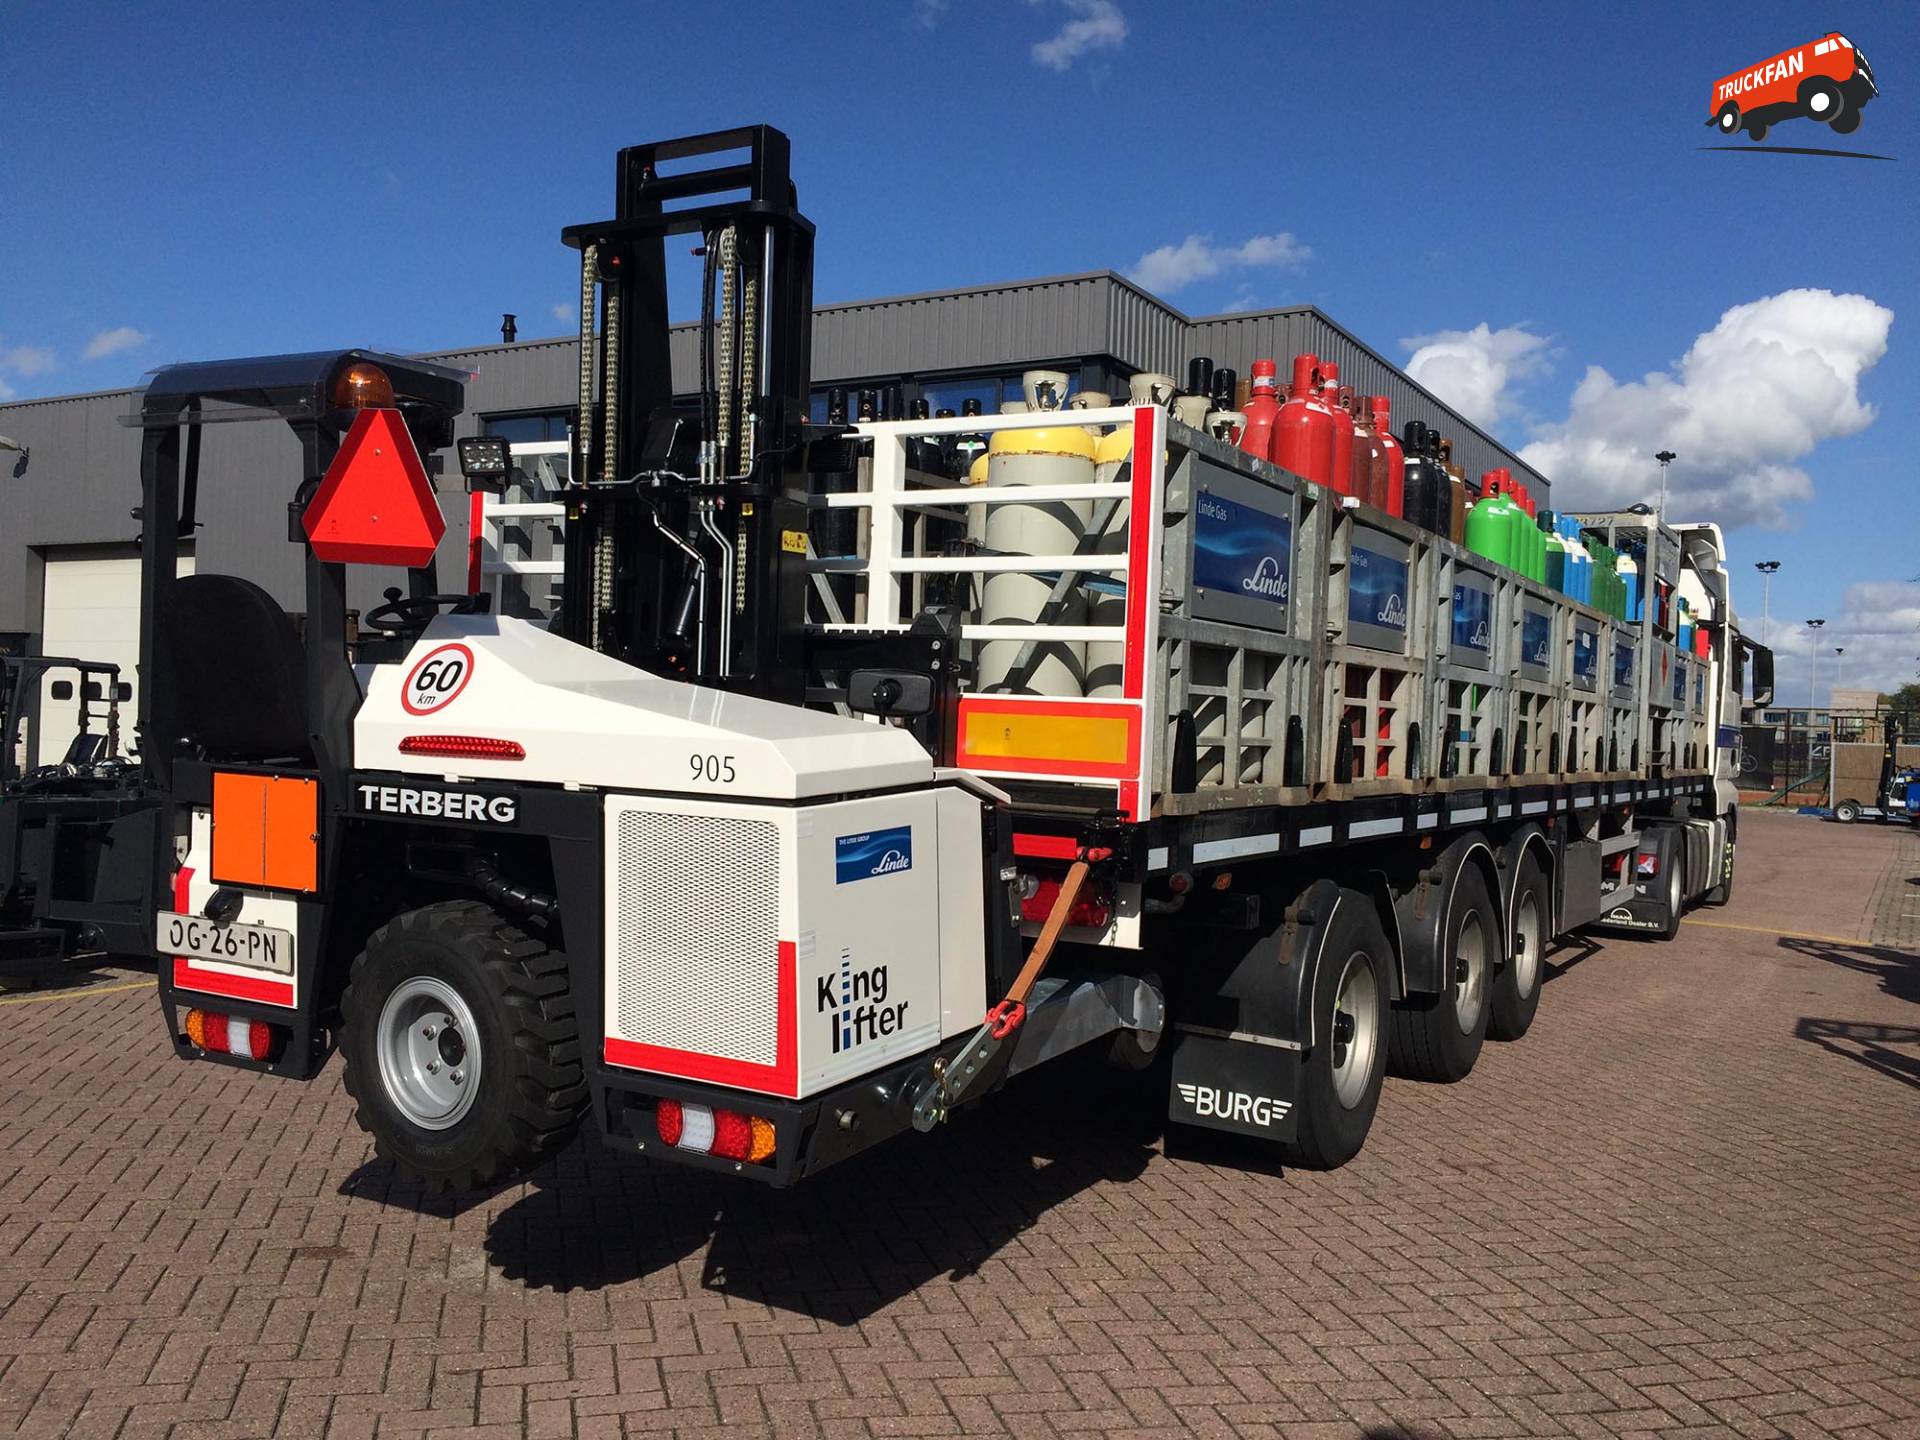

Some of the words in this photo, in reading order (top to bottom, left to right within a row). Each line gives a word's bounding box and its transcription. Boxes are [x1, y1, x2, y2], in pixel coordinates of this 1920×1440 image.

[1198, 499, 1215, 518] Linde
[1215, 504, 1227, 521] Gas
[1242, 556, 1288, 598] Linde
[1377, 593, 1406, 627] Linde
[415, 659, 464, 692] 60
[416, 693, 436, 705] km
[690, 754, 736, 783] 905
[358, 785, 516, 823] TERBERG
[871, 849, 909, 874] Linde
[169, 919, 277, 963] OG-26-PN
[817, 959, 888, 1013] King
[1195, 1086, 1272, 1127] BURG
